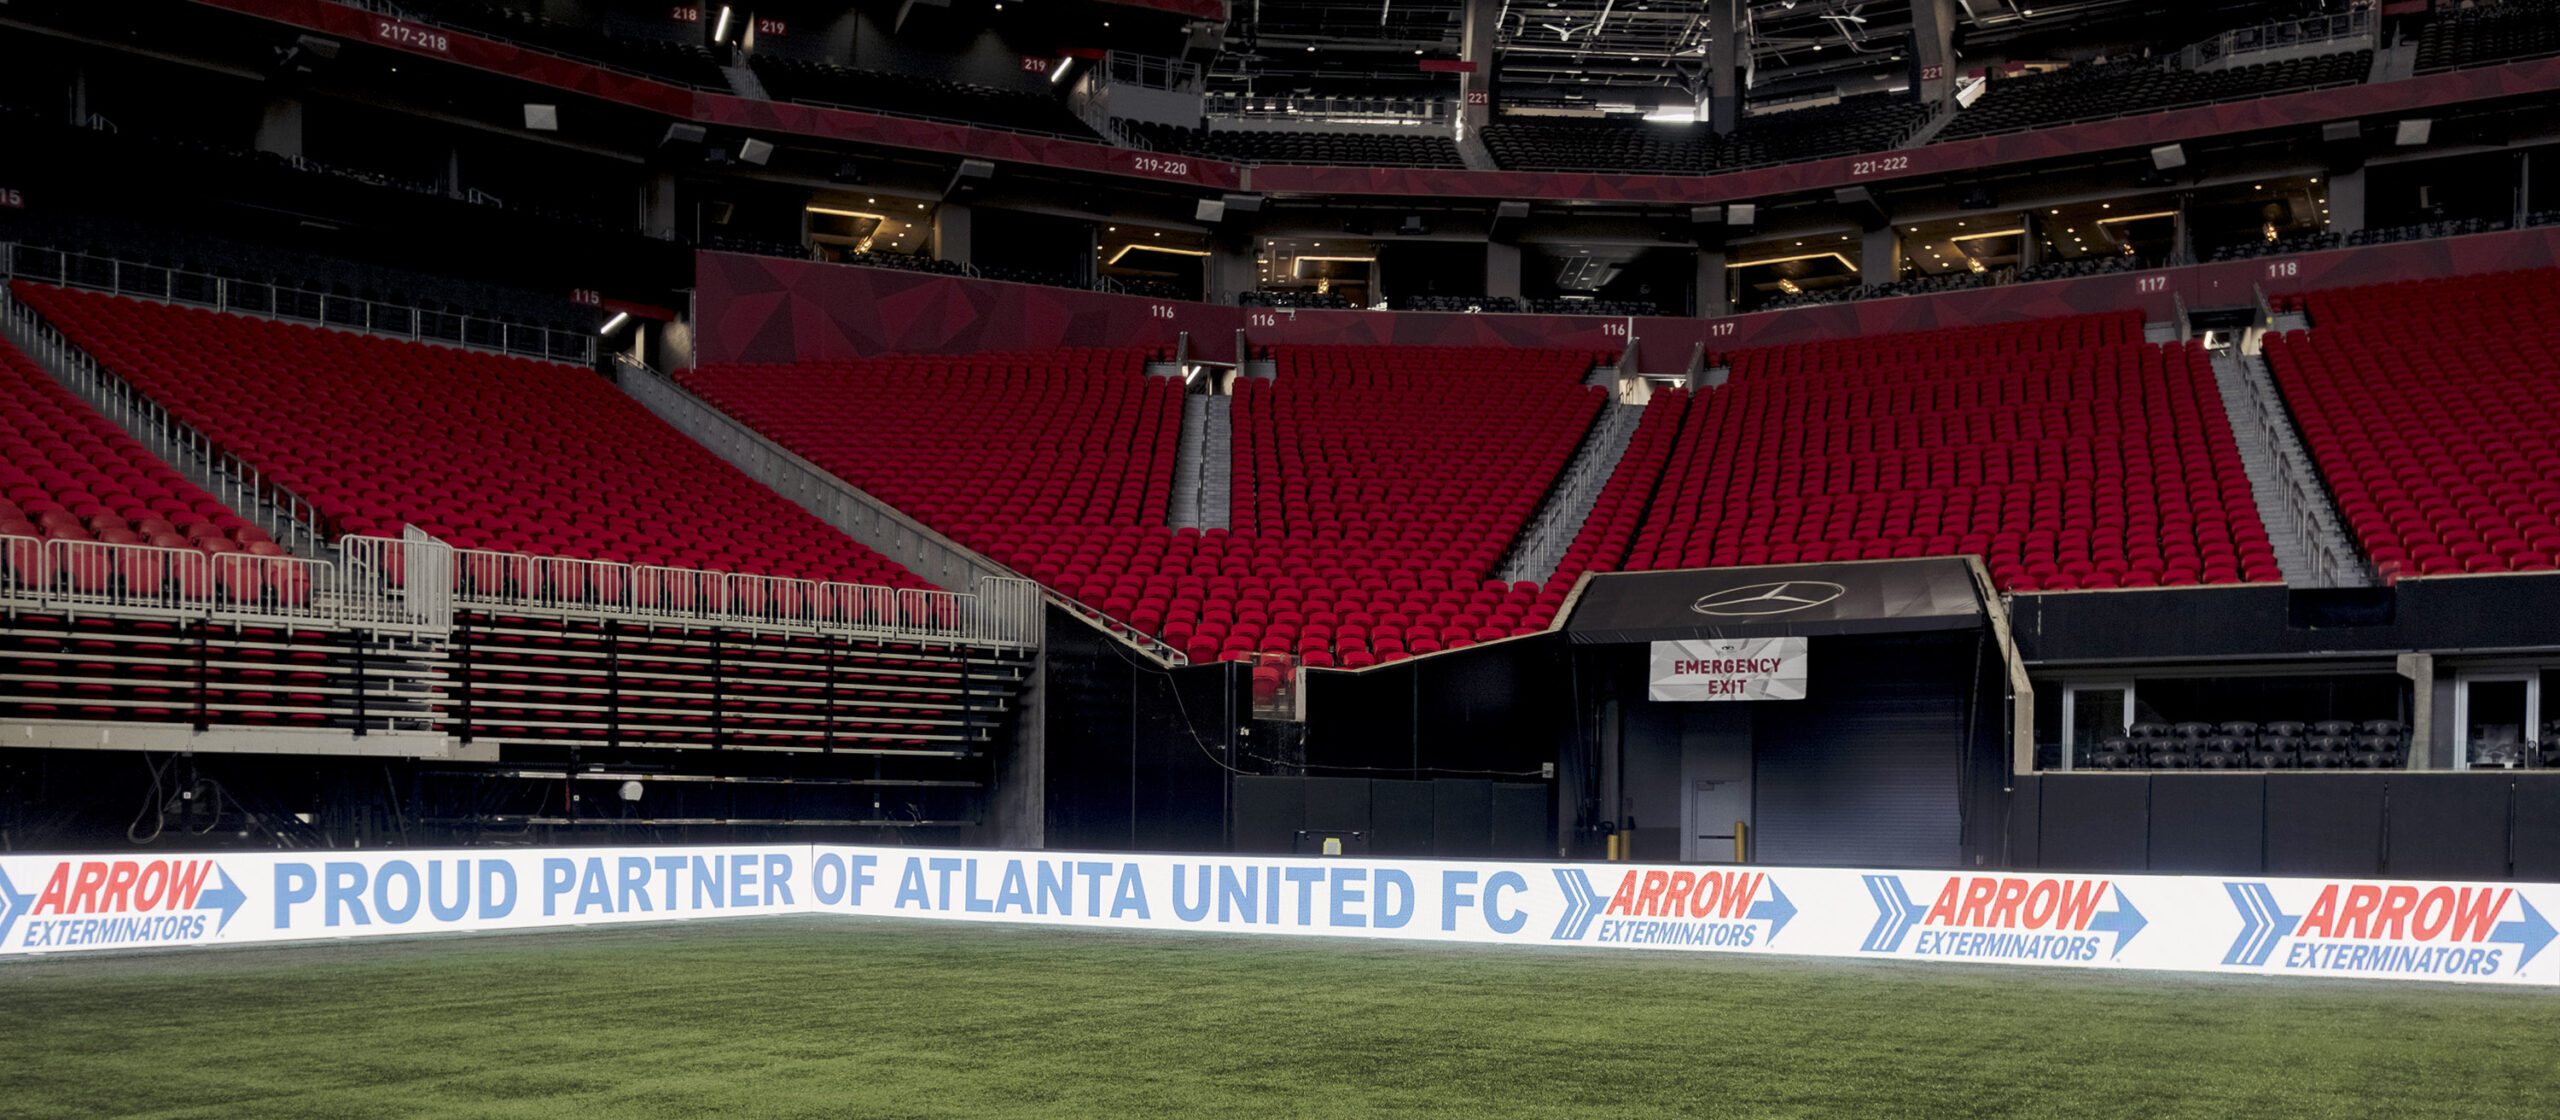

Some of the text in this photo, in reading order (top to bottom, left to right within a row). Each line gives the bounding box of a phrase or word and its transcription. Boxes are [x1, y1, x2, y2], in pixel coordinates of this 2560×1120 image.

[673, 7, 697, 20] 218
[761, 20, 784, 34] 219
[381, 23, 447, 51] 217-218
[1024, 58, 1046, 72] 219
[1921, 66, 1943, 80] 221
[1468, 92, 1488, 104] 221
[1135, 157, 1187, 175] 219-220
[1853, 156, 1908, 175] 221-222
[2269, 262, 2297, 277] 118
[2139, 276, 2166, 292] 117
[574, 288, 599, 304] 115
[1152, 305, 1174, 318] 116
[1251, 314, 1275, 326] 116
[1602, 323, 1625, 336] 116
[1712, 323, 1734, 336] 117
[1674, 658, 1781, 674] EMERGENCY
[1708, 680, 1747, 694] EXIT
[32, 860, 213, 915] ARROW
[273, 853, 1528, 934] PROUD PARTNER OF ATLANTA UNITED FC
[1606, 870, 1765, 919] ARROW
[1924, 877, 2109, 931] ARROW
[2296, 884, 2513, 942] ARROW
[22, 915, 207, 947] EXTERMINATORS
[1597, 920, 1757, 947] EXTERMINATORS
[1915, 931, 2100, 961] EXTERMINATORS
[2285, 943, 2502, 976] EXTERMINATORS
